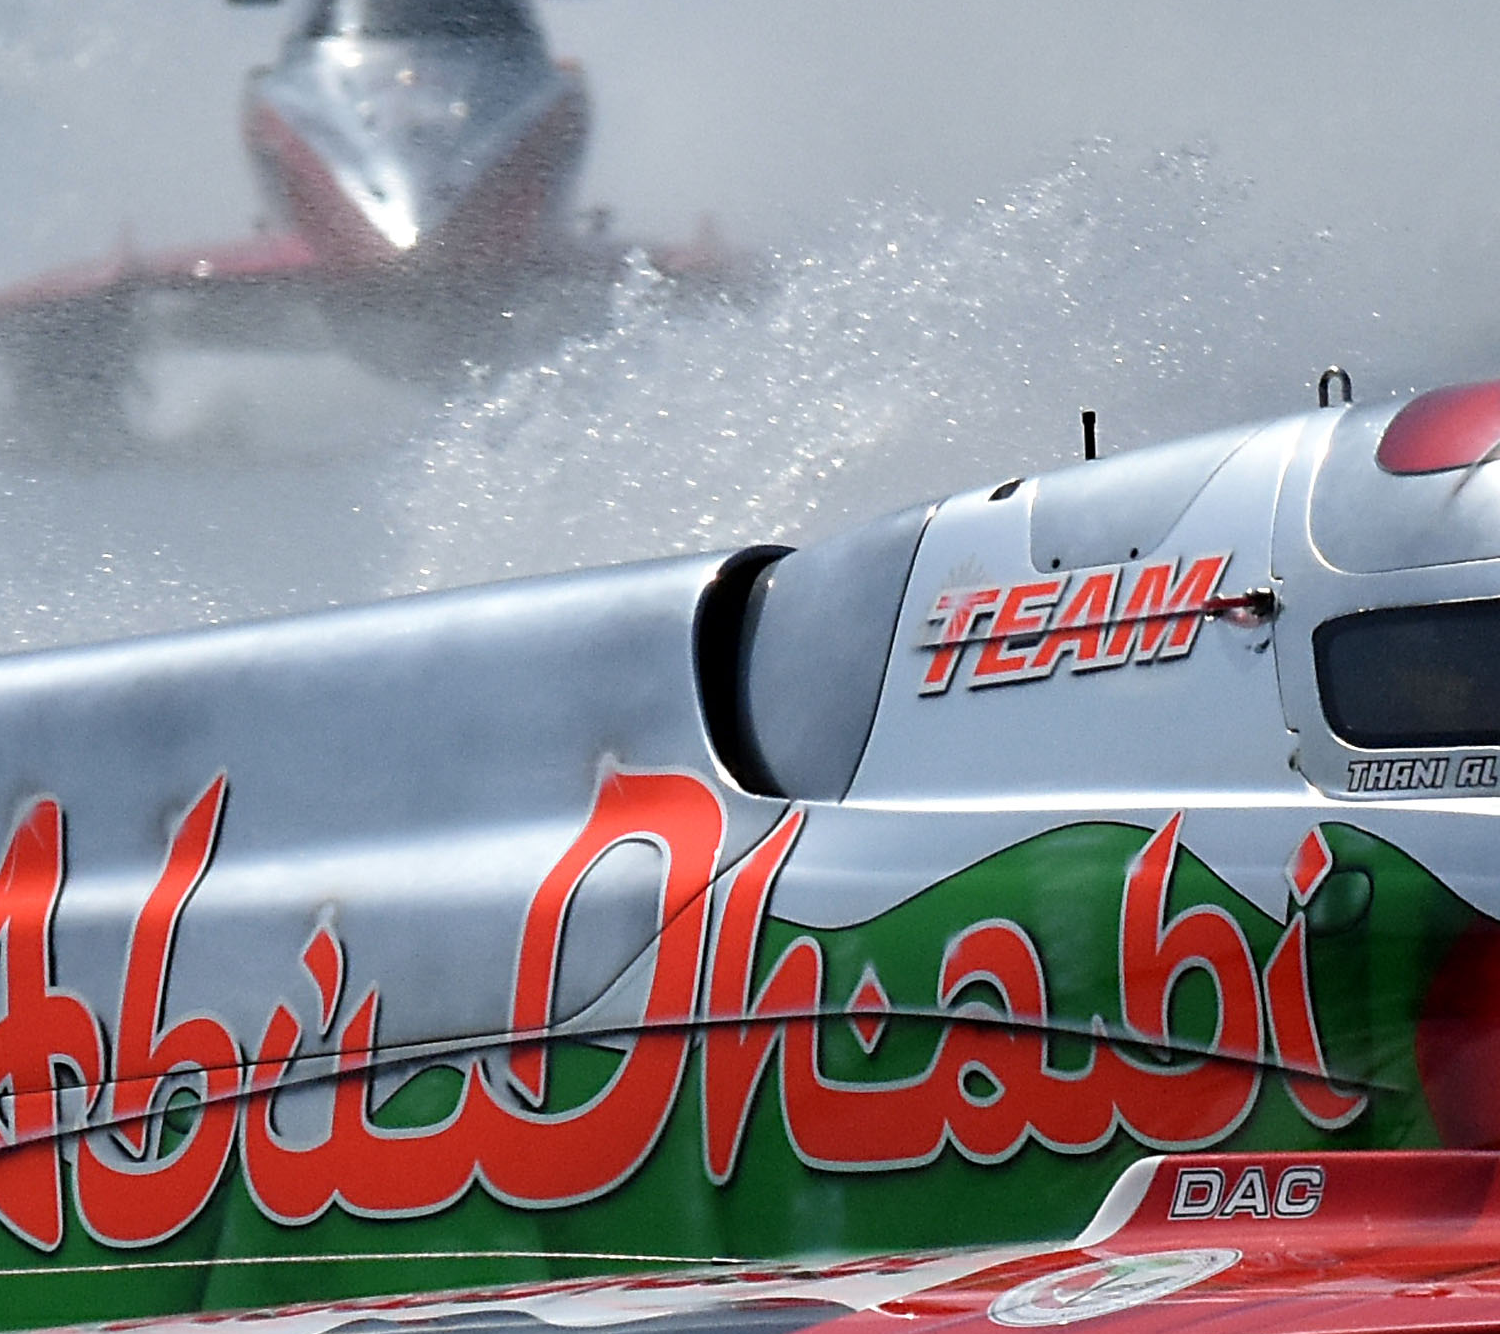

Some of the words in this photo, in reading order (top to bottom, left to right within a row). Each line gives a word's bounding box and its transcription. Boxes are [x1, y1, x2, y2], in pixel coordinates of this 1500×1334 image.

[914, 549, 1236, 698] TEAM
[1347, 757, 1450, 793] THANI
[1454, 754, 1500, 788] AL
[472, 761, 1369, 1209] Dhabi
[1168, 1166, 1326, 1220] DAC
